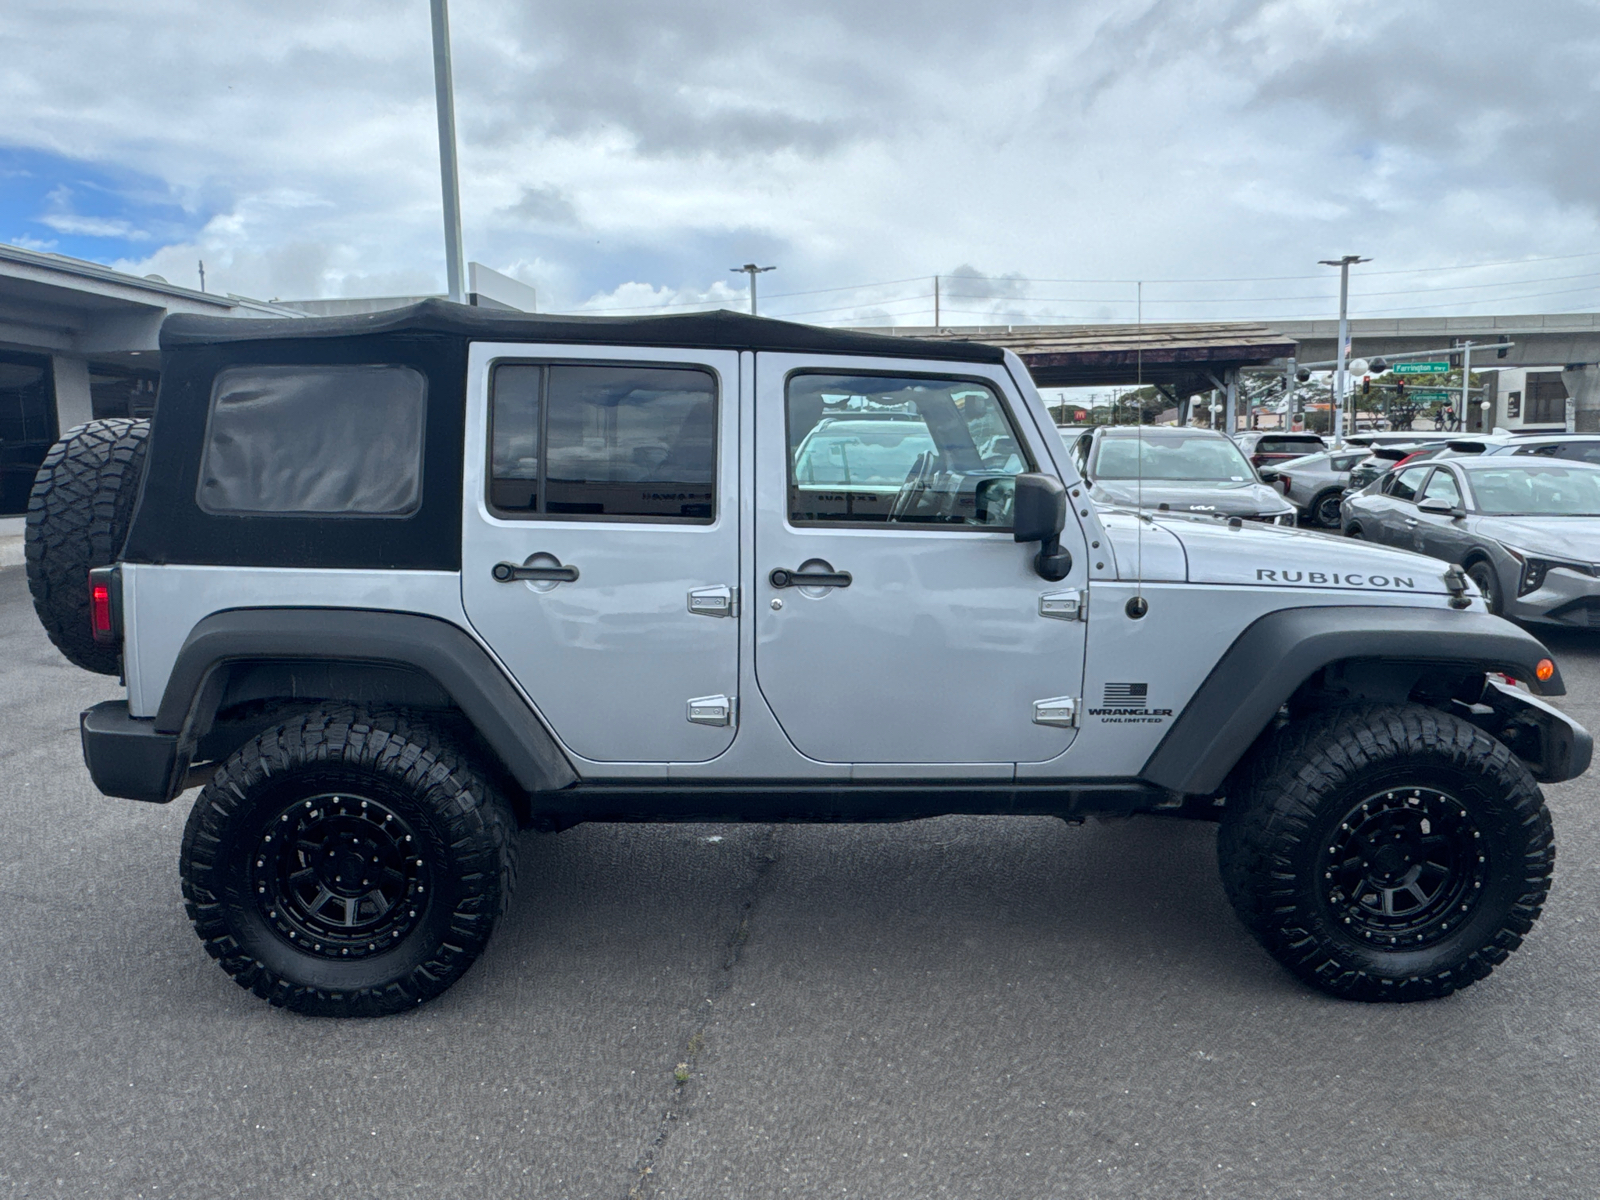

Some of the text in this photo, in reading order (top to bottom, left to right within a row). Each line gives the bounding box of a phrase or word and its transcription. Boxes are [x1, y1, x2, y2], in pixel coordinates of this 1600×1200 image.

[1396, 365, 1431, 373] Farrington
[1256, 569, 1415, 588] RUBICON
[1088, 708, 1173, 716] WRANGLER
